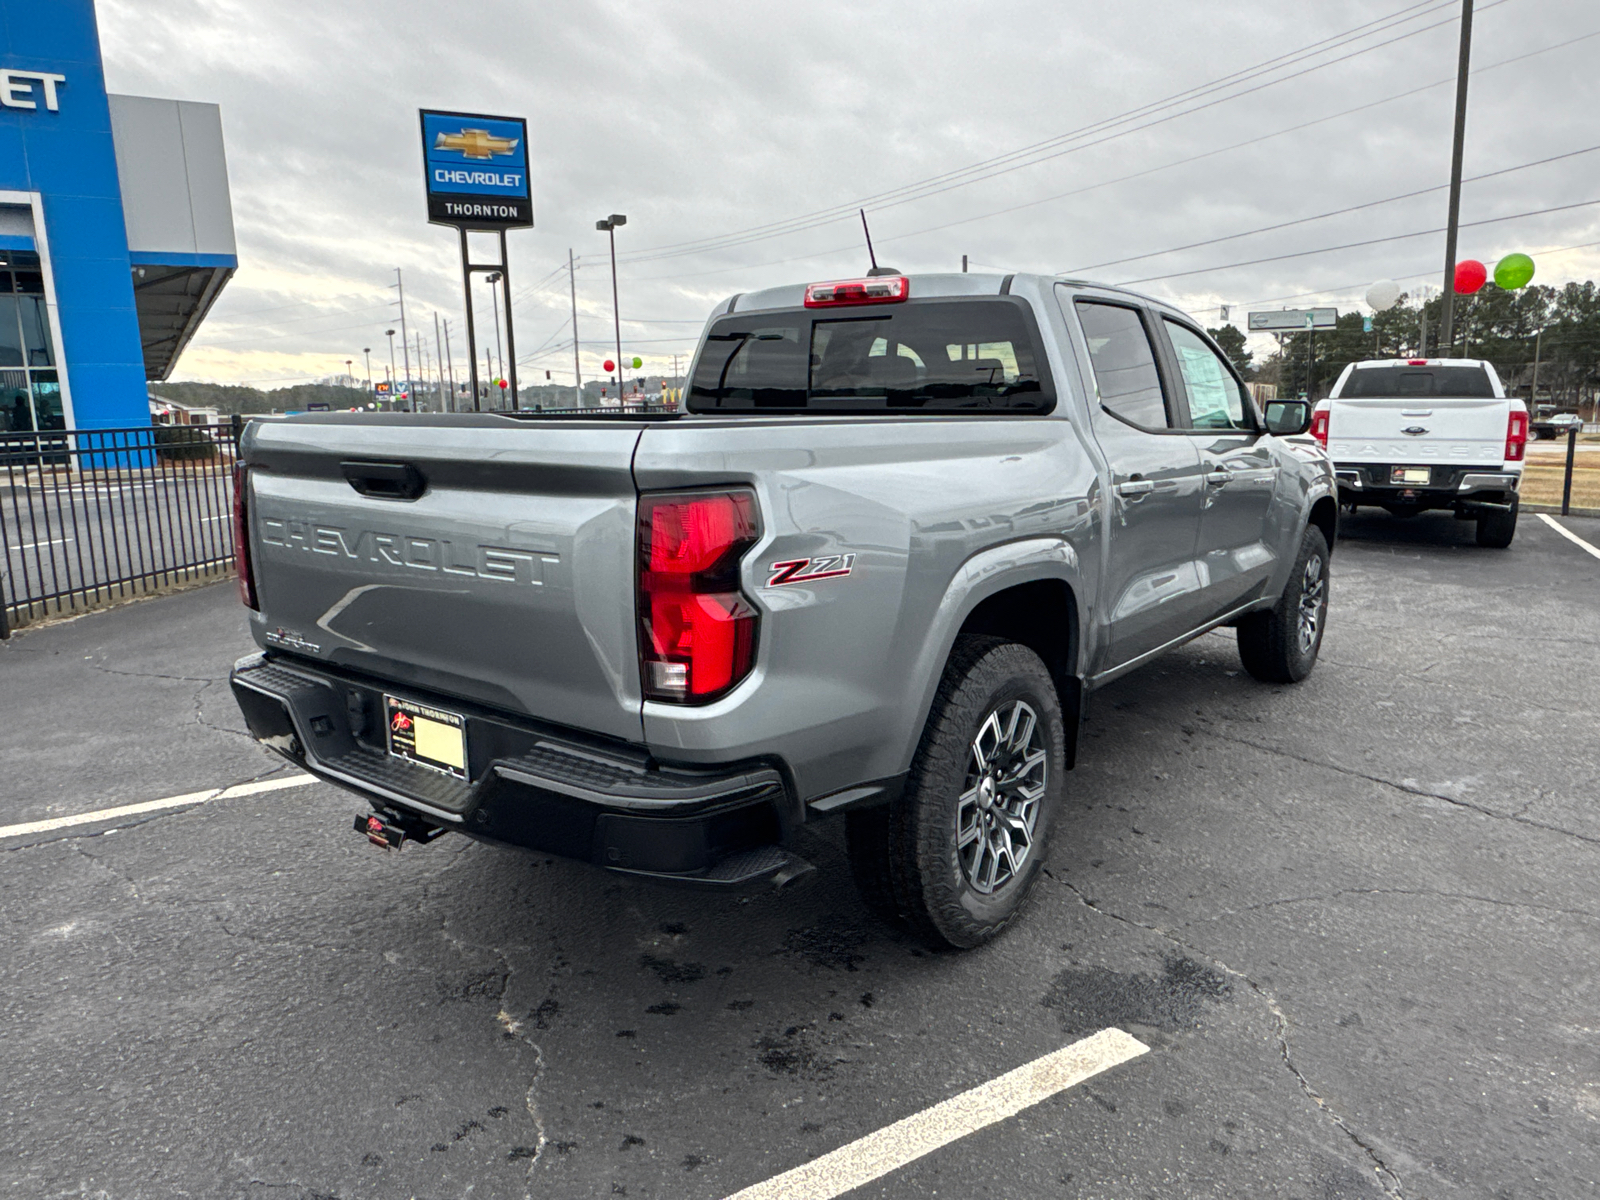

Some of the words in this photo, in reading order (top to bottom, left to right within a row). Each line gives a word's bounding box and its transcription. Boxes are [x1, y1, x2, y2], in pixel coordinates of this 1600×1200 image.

[434, 169, 522, 187] CHEVROLET
[445, 202, 518, 218] THORNTON
[1332, 443, 1500, 458] RANGER
[261, 516, 560, 586] CHEVROLET
[764, 553, 857, 589] Z71
